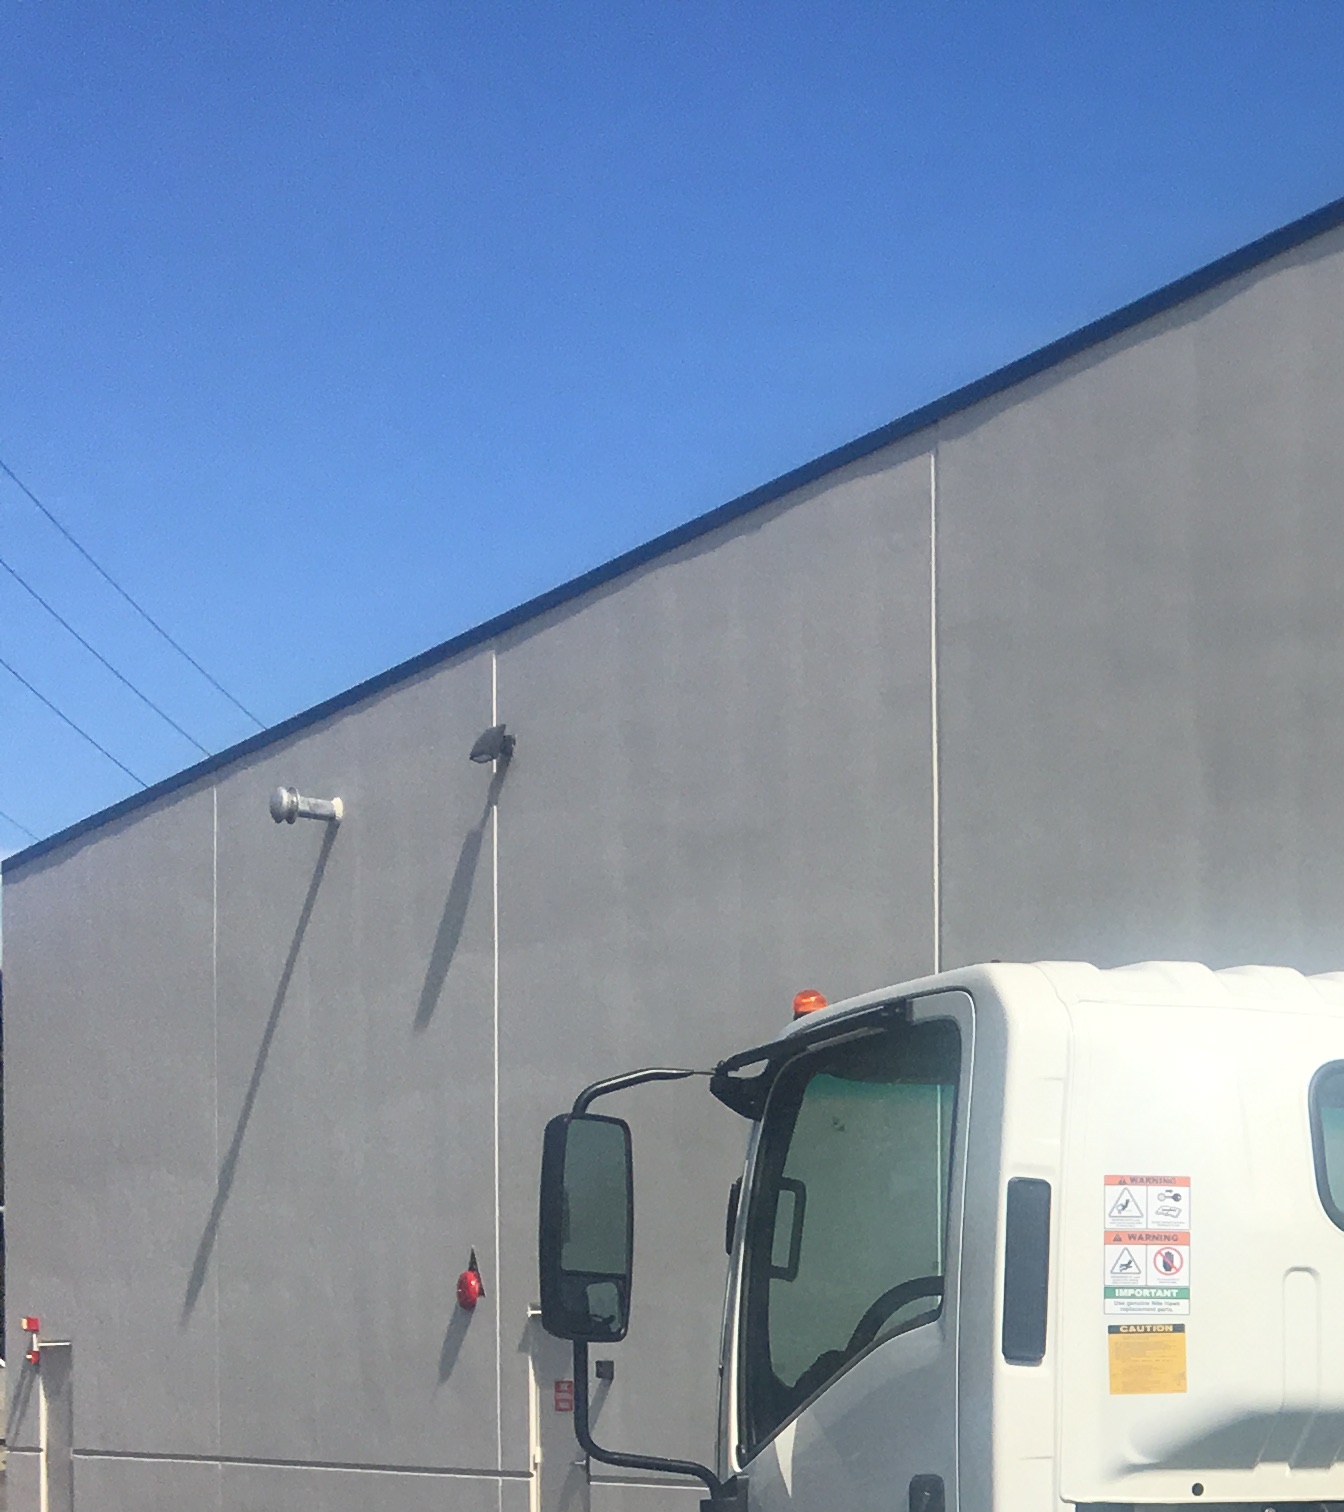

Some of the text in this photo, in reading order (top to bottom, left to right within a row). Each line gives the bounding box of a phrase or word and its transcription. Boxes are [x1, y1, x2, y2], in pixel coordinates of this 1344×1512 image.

[1129, 1177, 1177, 1185] WARNING
[1127, 1233, 1179, 1242] WARNING
[1115, 1288, 1179, 1298] IMPORTANT
[1119, 1325, 1173, 1333] CAUTION
